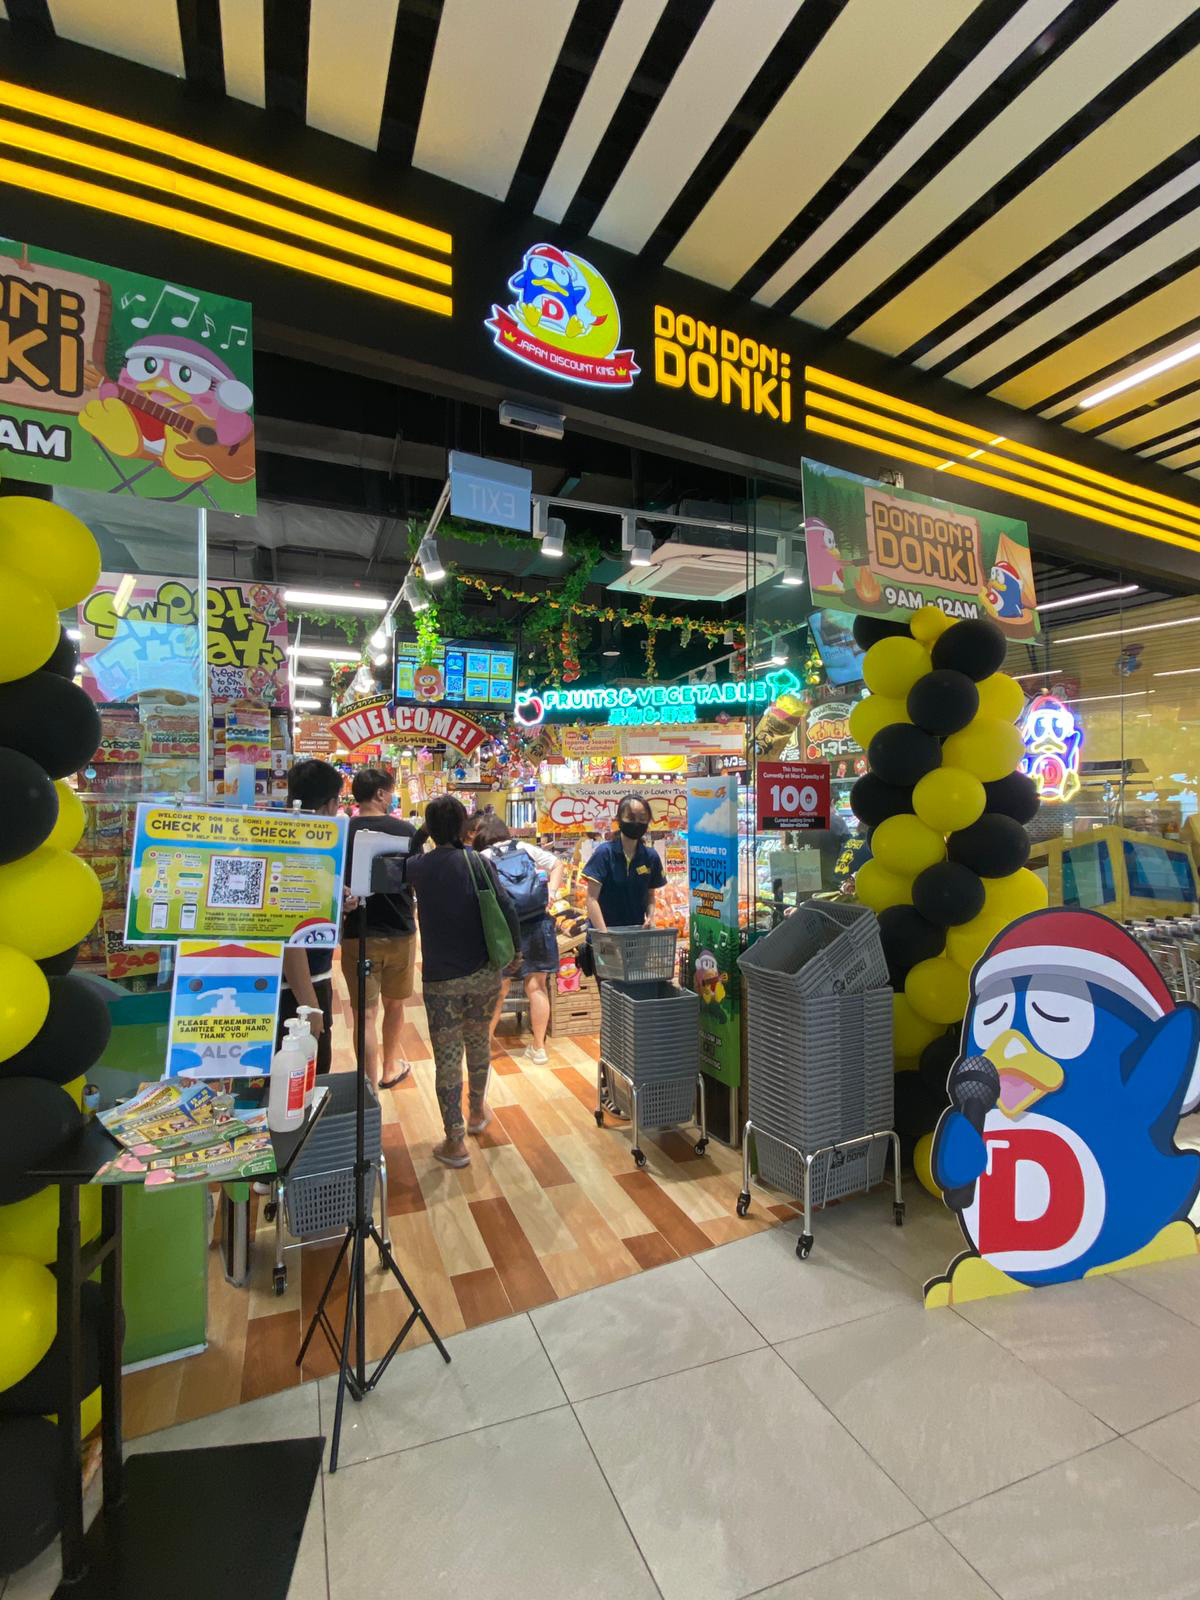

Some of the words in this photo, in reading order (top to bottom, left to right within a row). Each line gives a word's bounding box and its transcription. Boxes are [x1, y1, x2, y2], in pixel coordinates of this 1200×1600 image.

[654, 304, 717, 355] DON
[721, 329, 778, 375] DON
[0, 319, 78, 394] KI
[516, 338, 549, 360] JAPAN
[549, 352, 594, 374] DISCOUNT
[595, 364, 616, 377] KING
[874, 502, 919, 536] DON
[920, 514, 963, 548] DON
[884, 586, 923, 610] 9AM
[339, 705, 477, 750] WELCOME!
[770, 784, 818, 813] 100
[158, 812, 193, 820] WELCOME
[151, 819, 201, 833] CHECK
[210, 823, 223, 834] IN
[250, 826, 297, 839] CHECK
[305, 830, 333, 841] OUT
[689, 845, 718, 855] WELCOME
[718, 847, 727, 856] TO
[690, 867, 727, 888] DONKI
[177, 1019, 210, 1027] PLEASE
[213, 1018, 258, 1026] REMEMBER
[180, 1025, 217, 1033] SANITIZE
[200, 1032, 227, 1040] THANK
[202, 1045, 243, 1059] ALC
